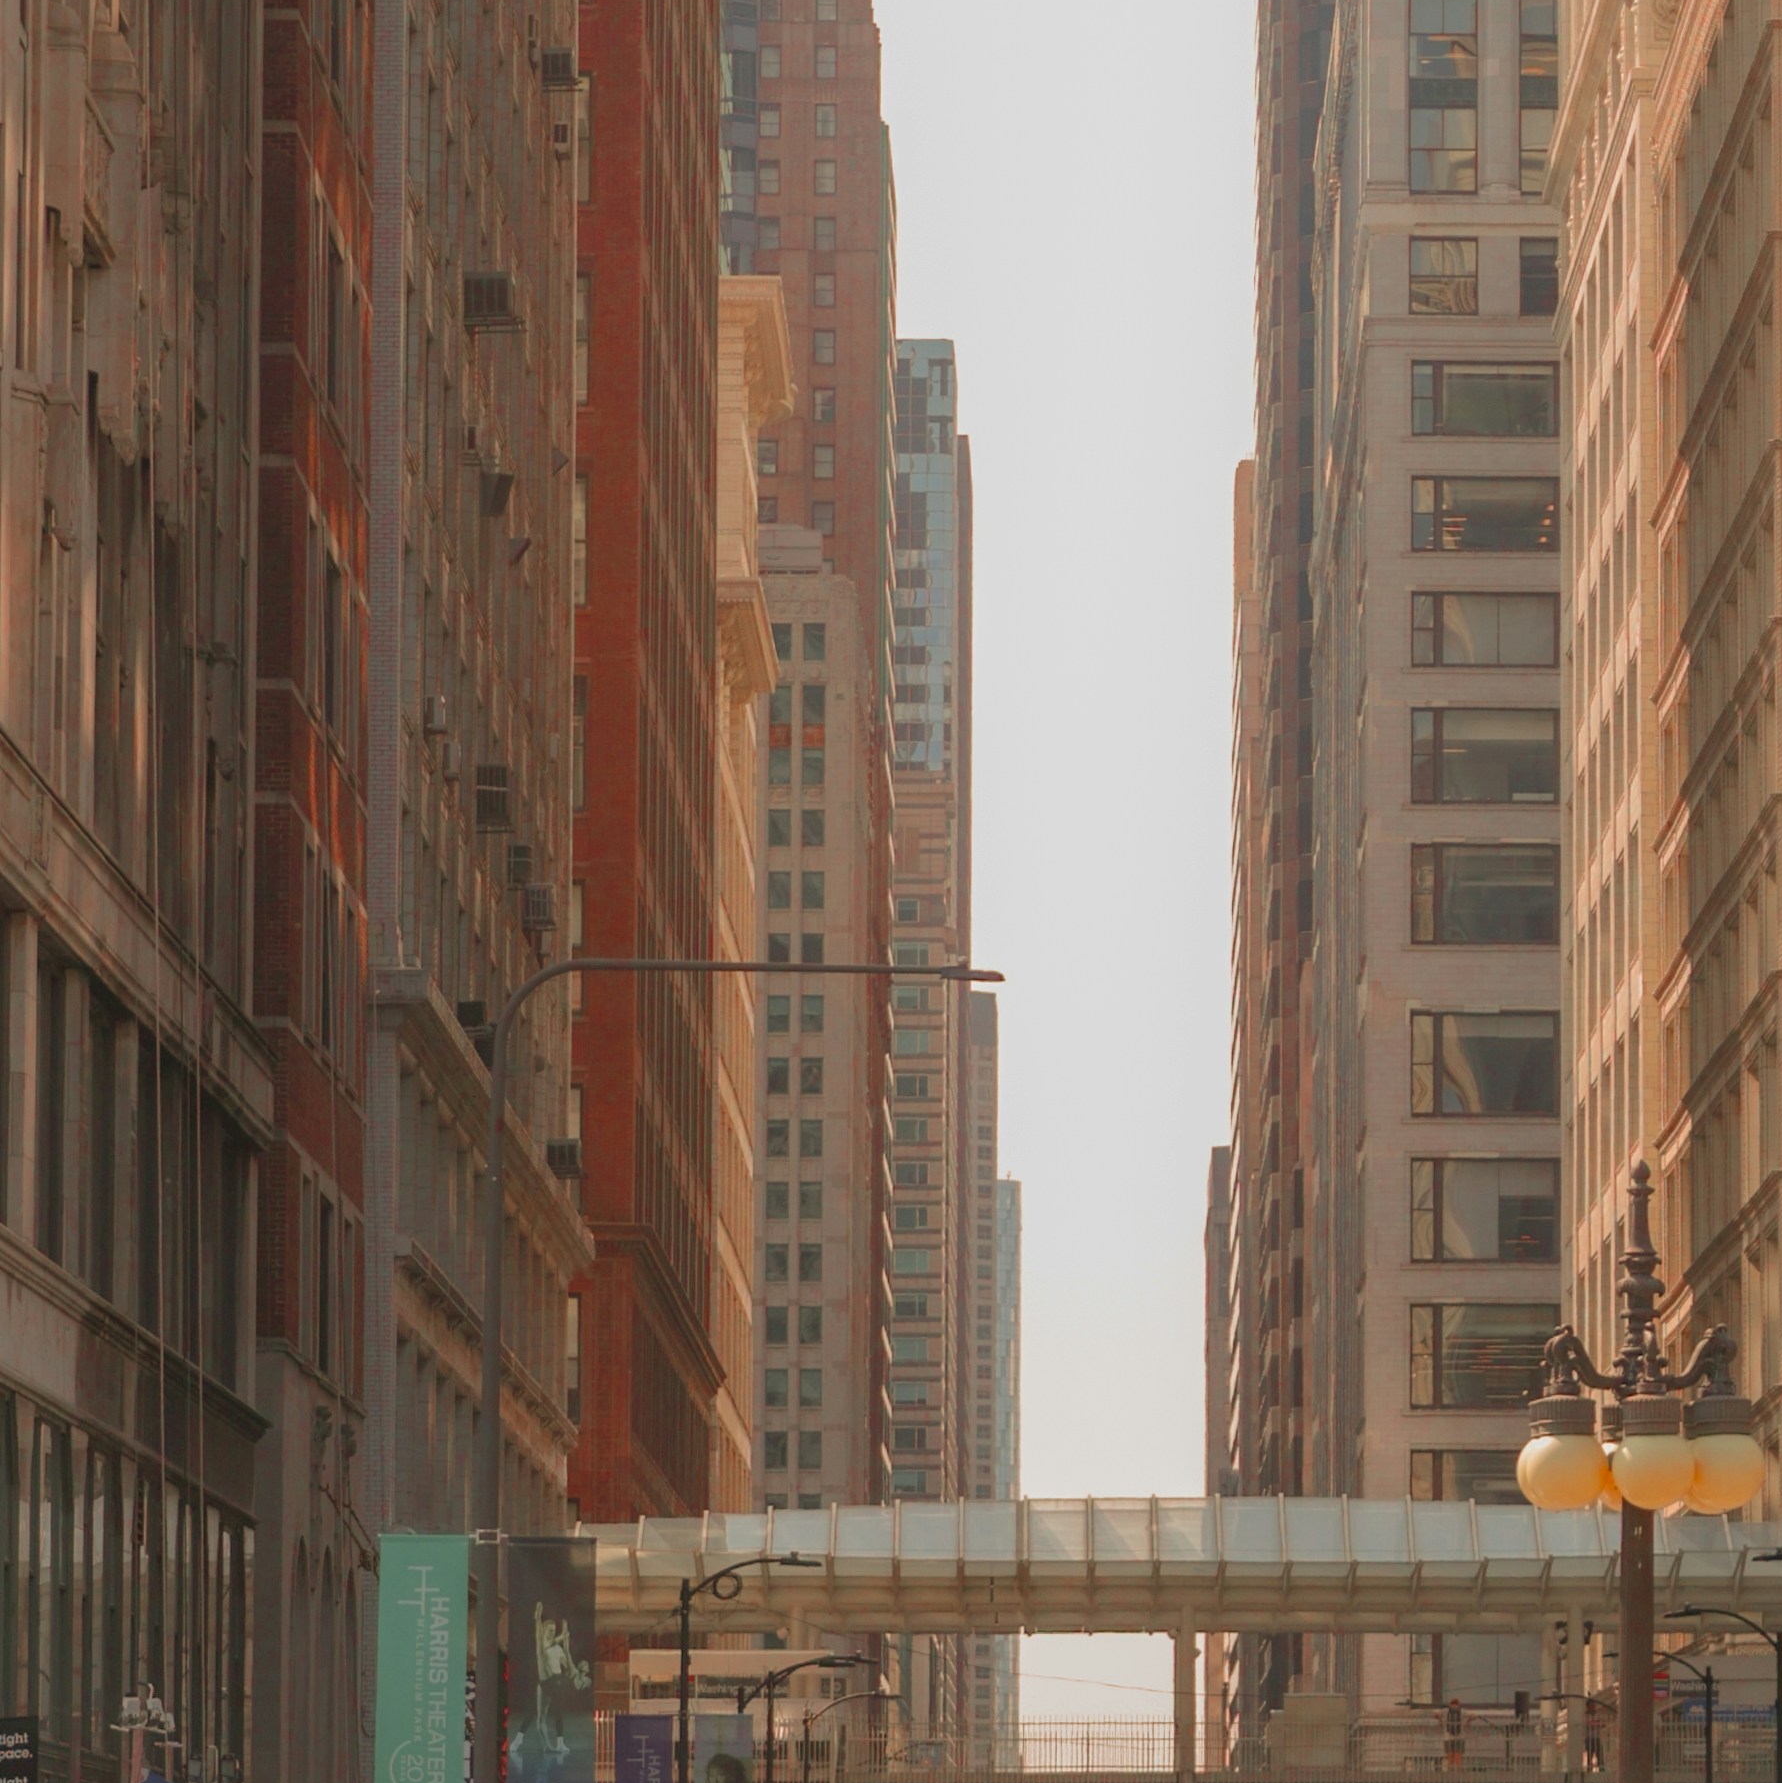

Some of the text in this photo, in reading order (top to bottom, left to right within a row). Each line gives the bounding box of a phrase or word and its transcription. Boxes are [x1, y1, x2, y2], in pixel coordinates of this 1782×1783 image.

[427, 1597, 449, 1685] HARRIS
[414, 1618, 424, 1743] MILLENNIUM PARK
[697, 1683, 755, 1695] Washingon
[0, 1749, 33, 1762] pace.
[407, 1755, 424, 1783] 20
